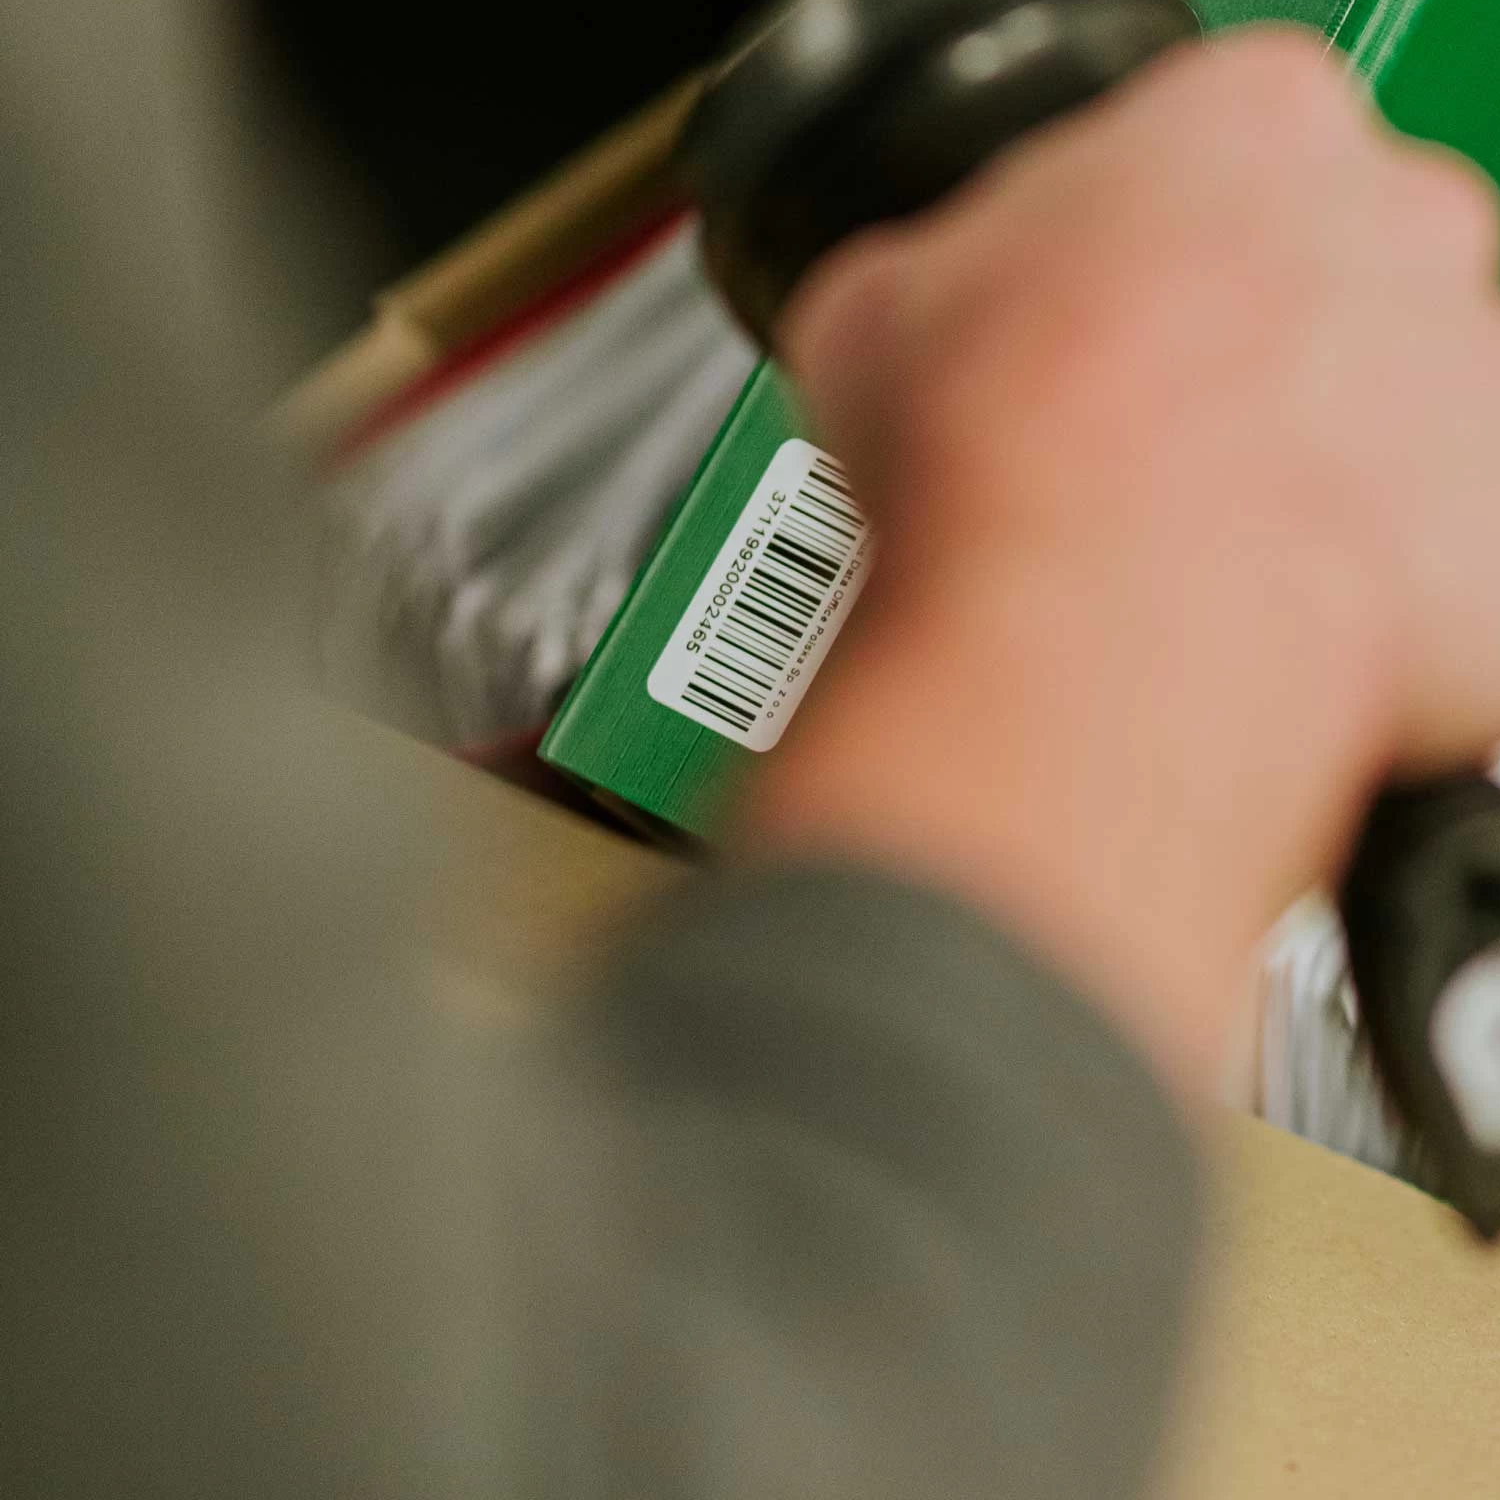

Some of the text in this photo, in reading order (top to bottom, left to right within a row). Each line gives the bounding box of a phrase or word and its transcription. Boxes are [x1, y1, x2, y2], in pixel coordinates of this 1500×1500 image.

[685, 491, 787, 655] 37119920002465
[839, 558, 862, 588] Data
[820, 588, 845, 623] Office
